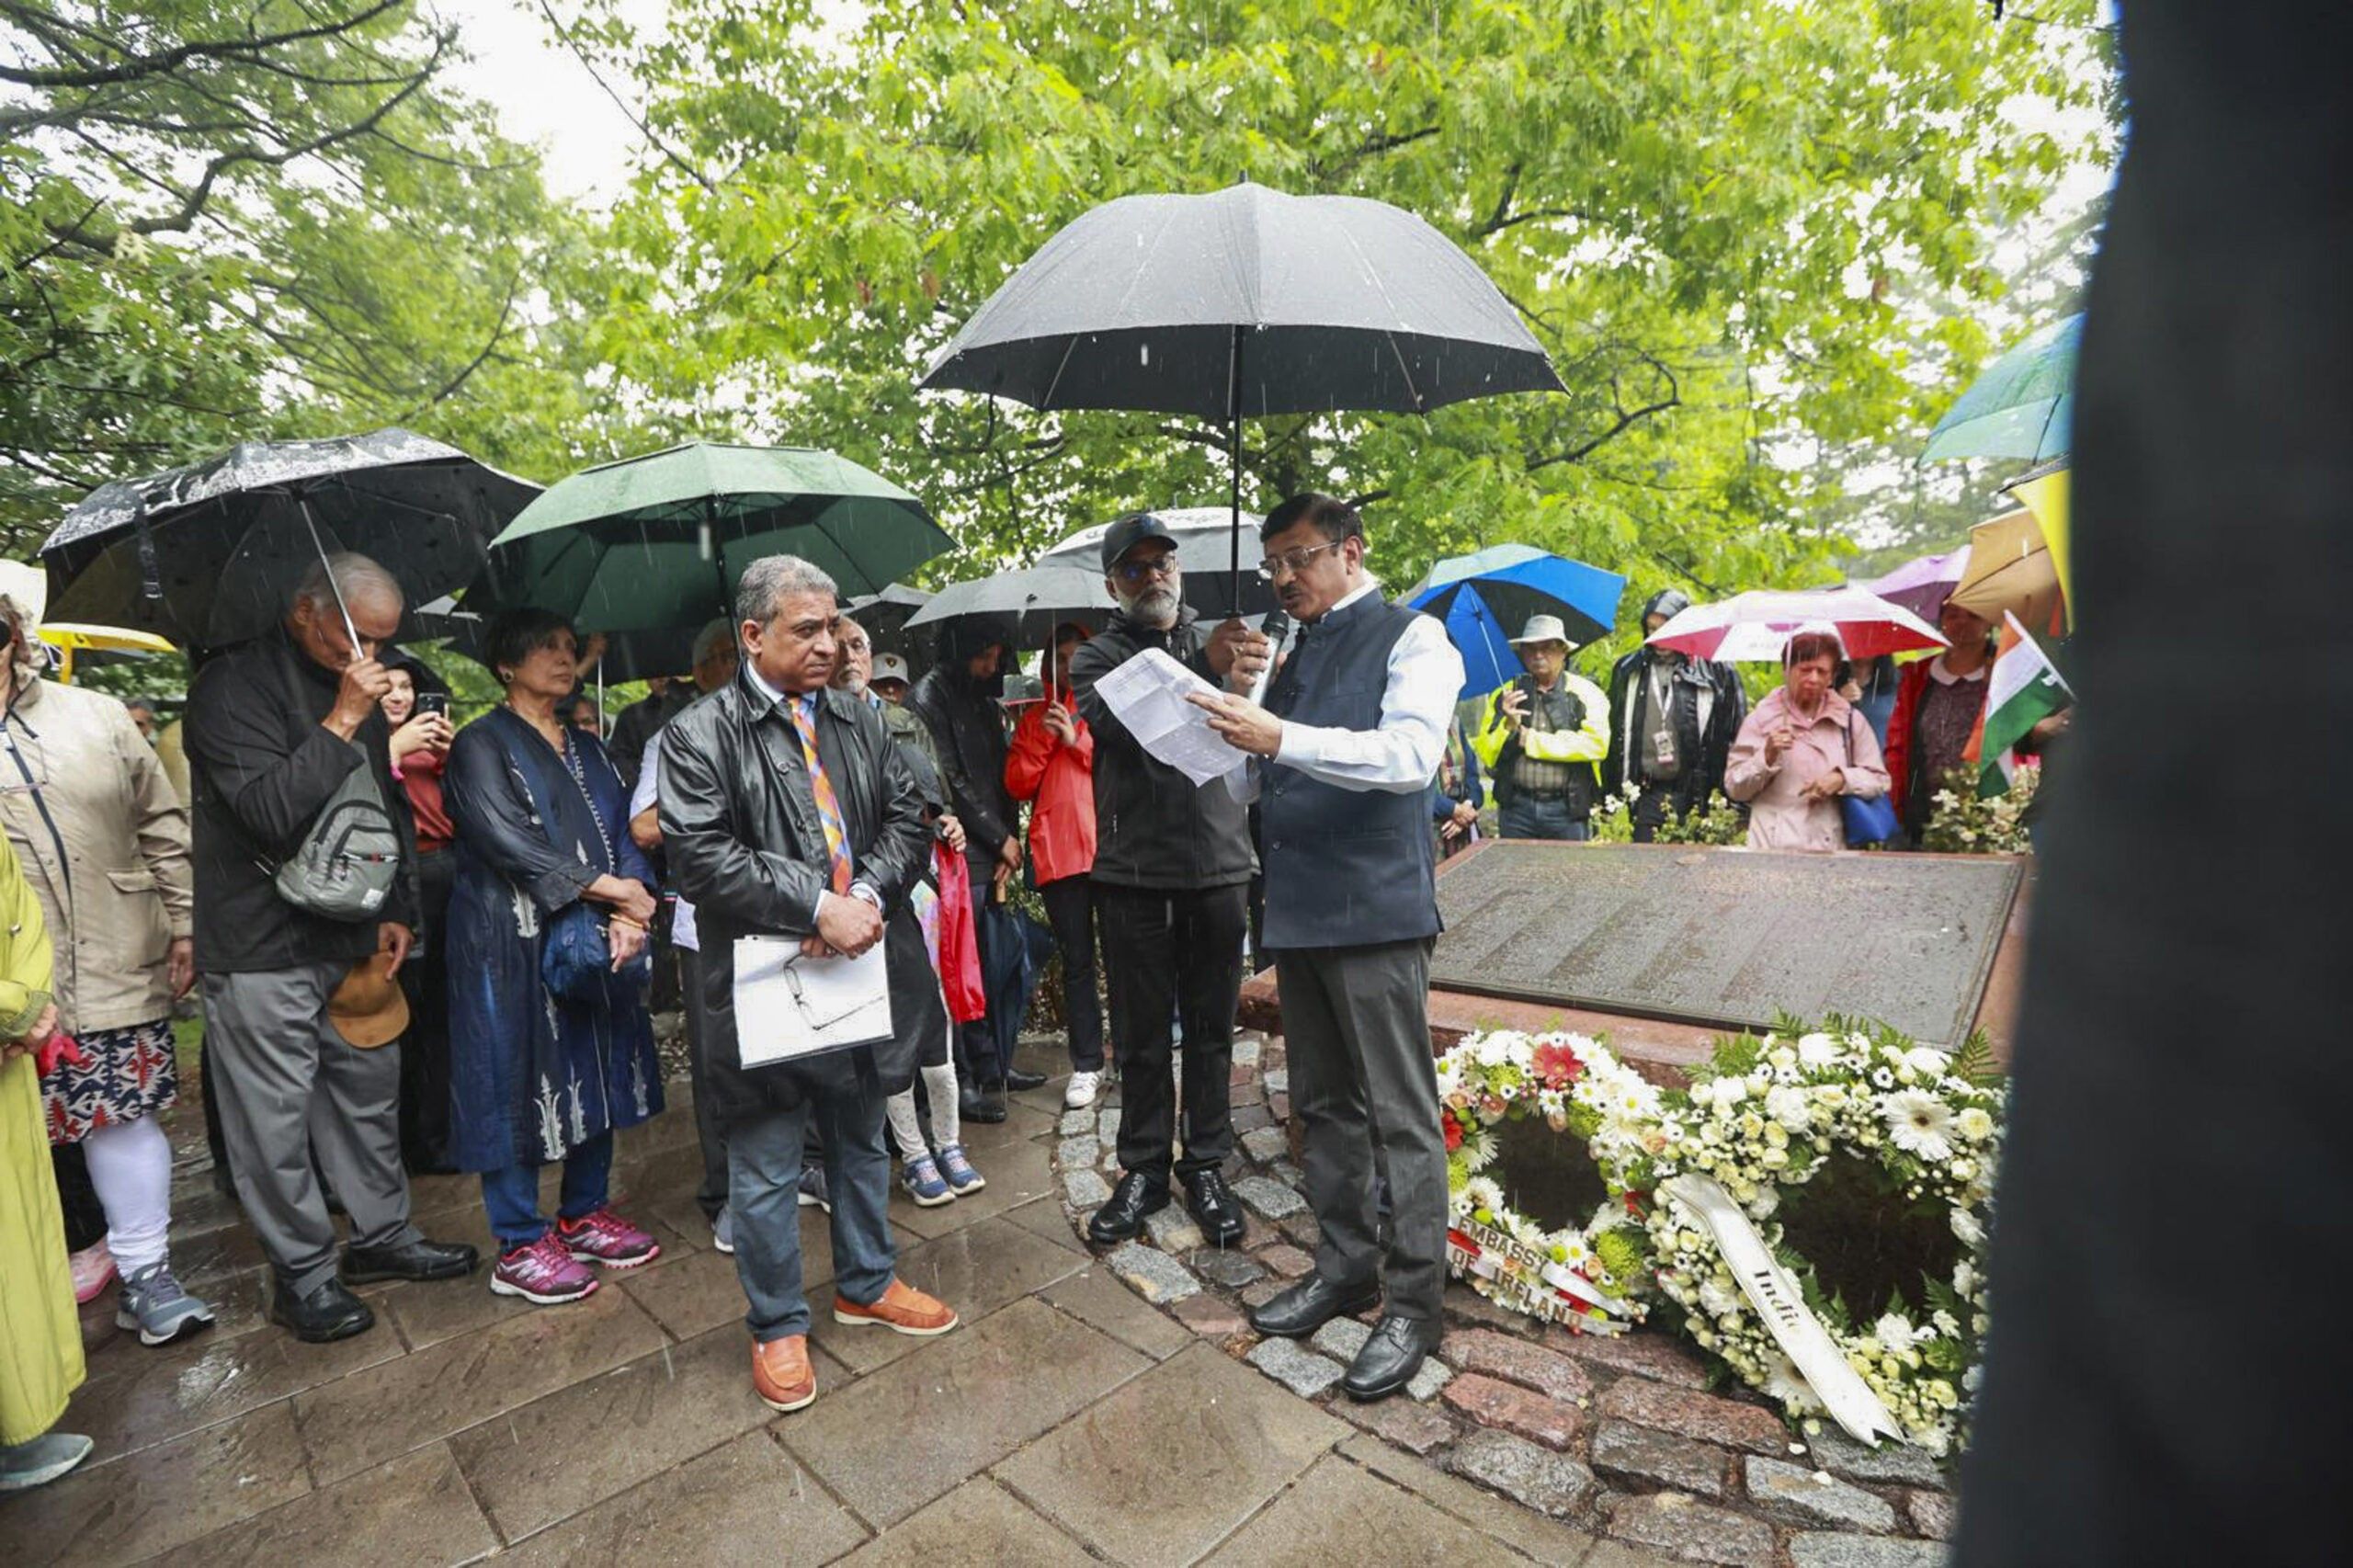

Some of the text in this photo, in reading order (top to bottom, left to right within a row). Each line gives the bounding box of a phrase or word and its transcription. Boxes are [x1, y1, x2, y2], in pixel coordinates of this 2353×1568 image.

[1458, 1216, 1549, 1275] EMBASSY
[1452, 1248, 1583, 1327] OF IRELAND
[1754, 1270, 1800, 1329] Indi
